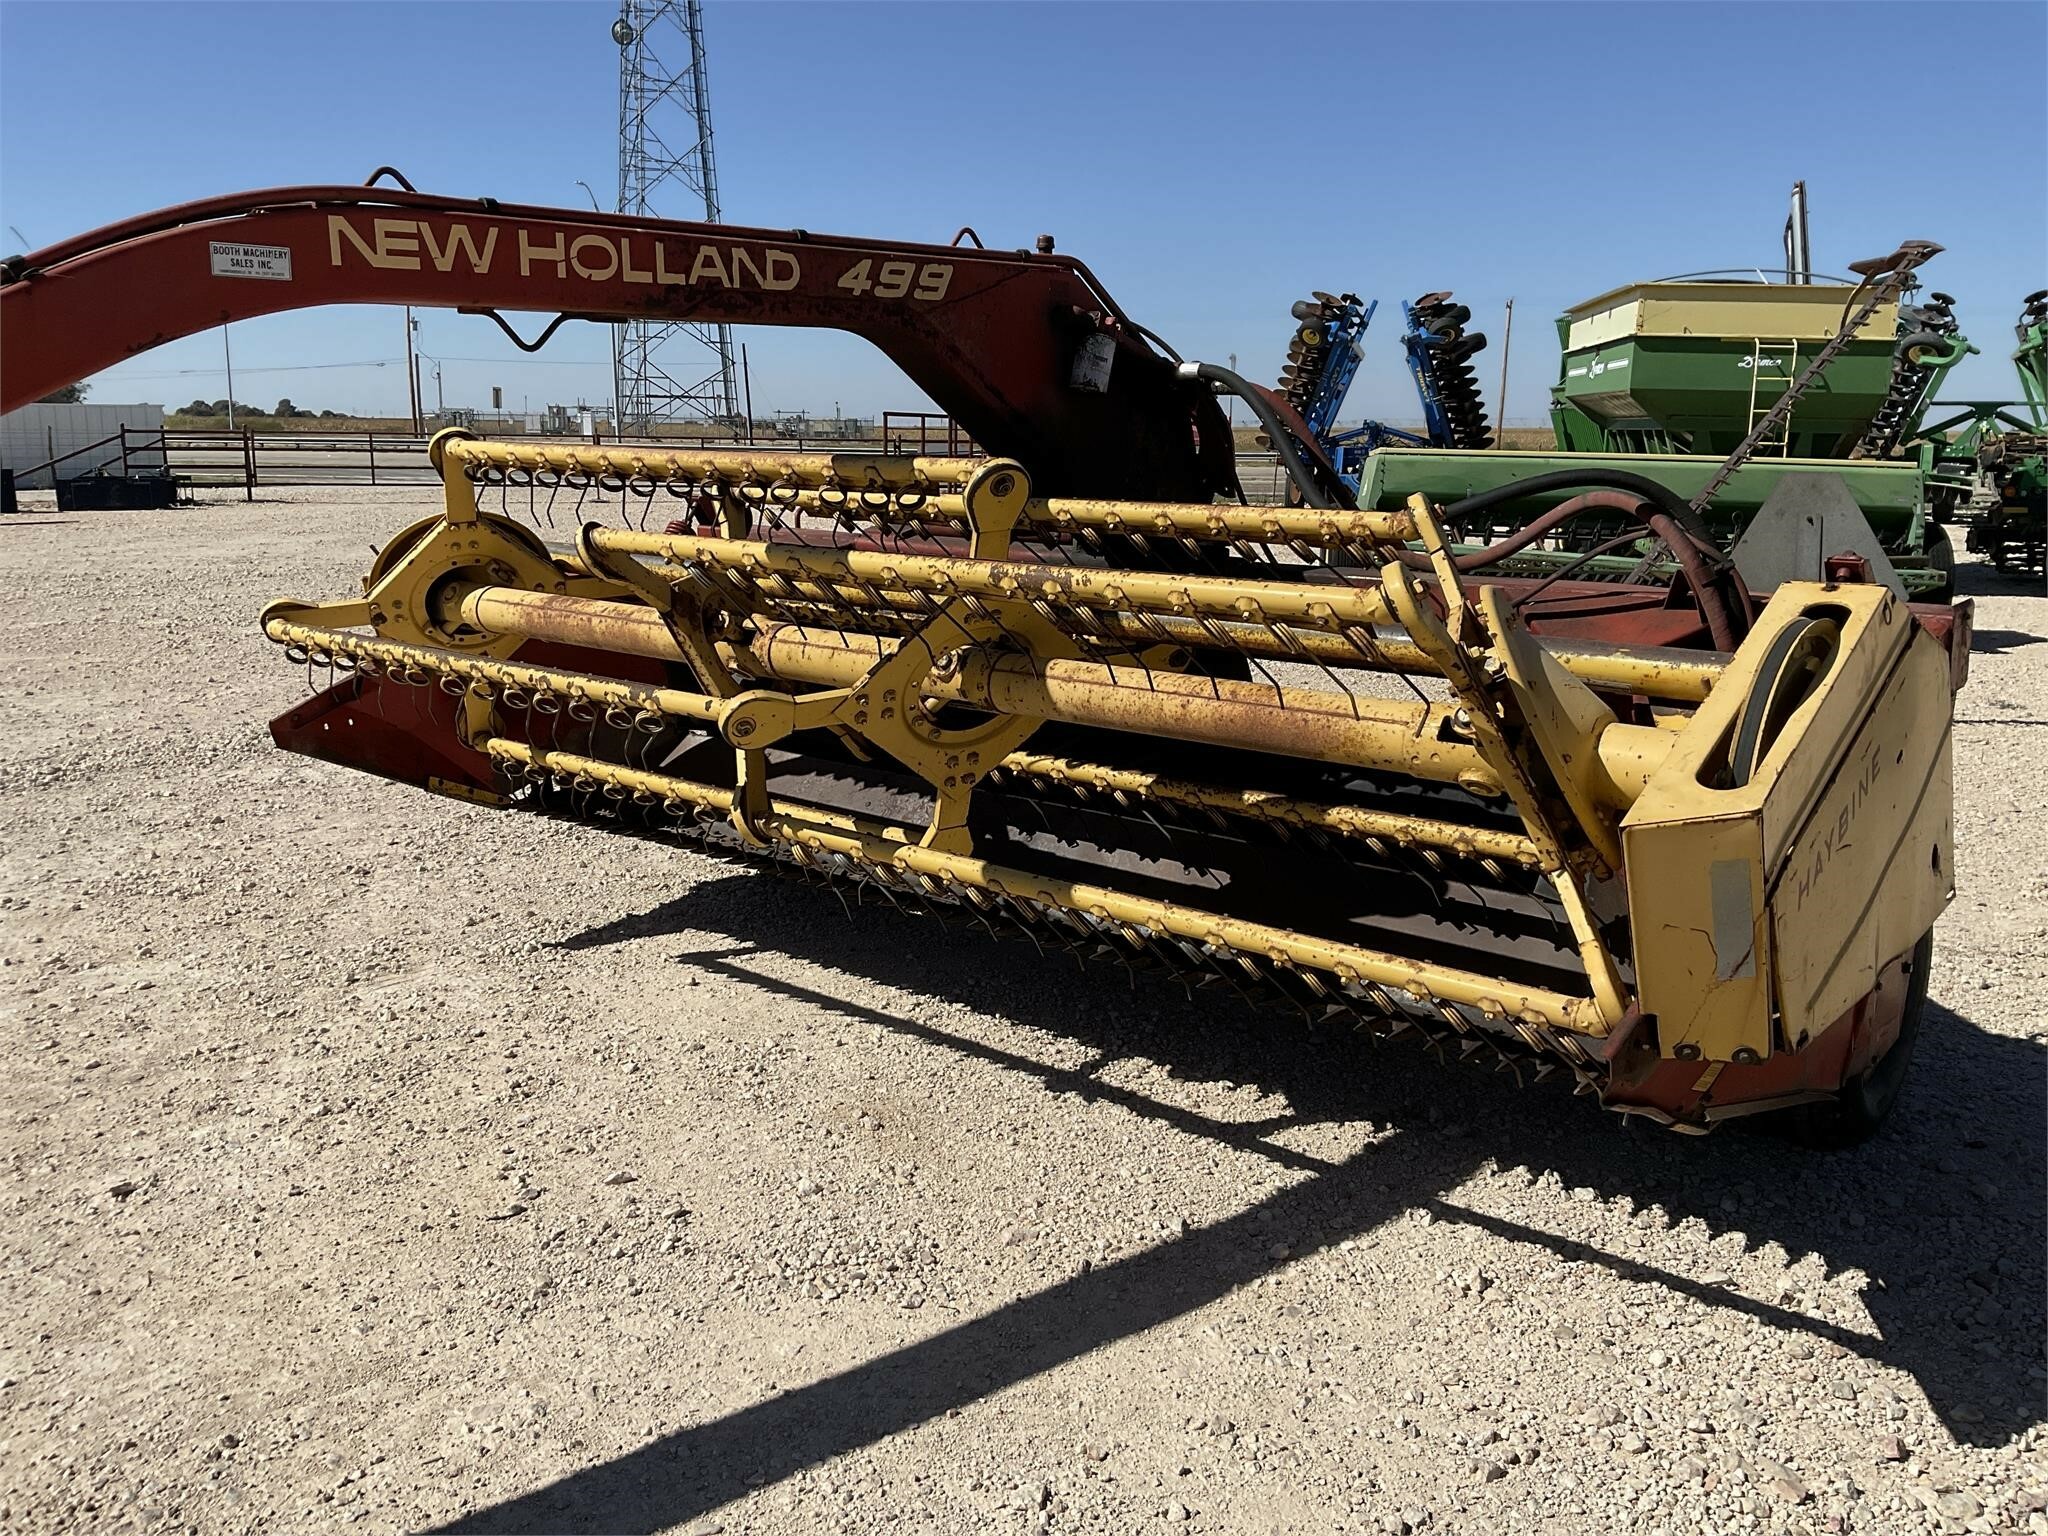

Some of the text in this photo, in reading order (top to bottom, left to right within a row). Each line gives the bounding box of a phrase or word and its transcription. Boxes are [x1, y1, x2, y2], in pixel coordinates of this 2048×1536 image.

[213, 245, 240, 255] BOOTH
[230, 258, 273, 270] SALES INC.
[328, 215, 954, 301] NEW HOLLAND 499
[1737, 355, 1782, 368] Dmco
[1798, 745, 1881, 912] HAYBINE
